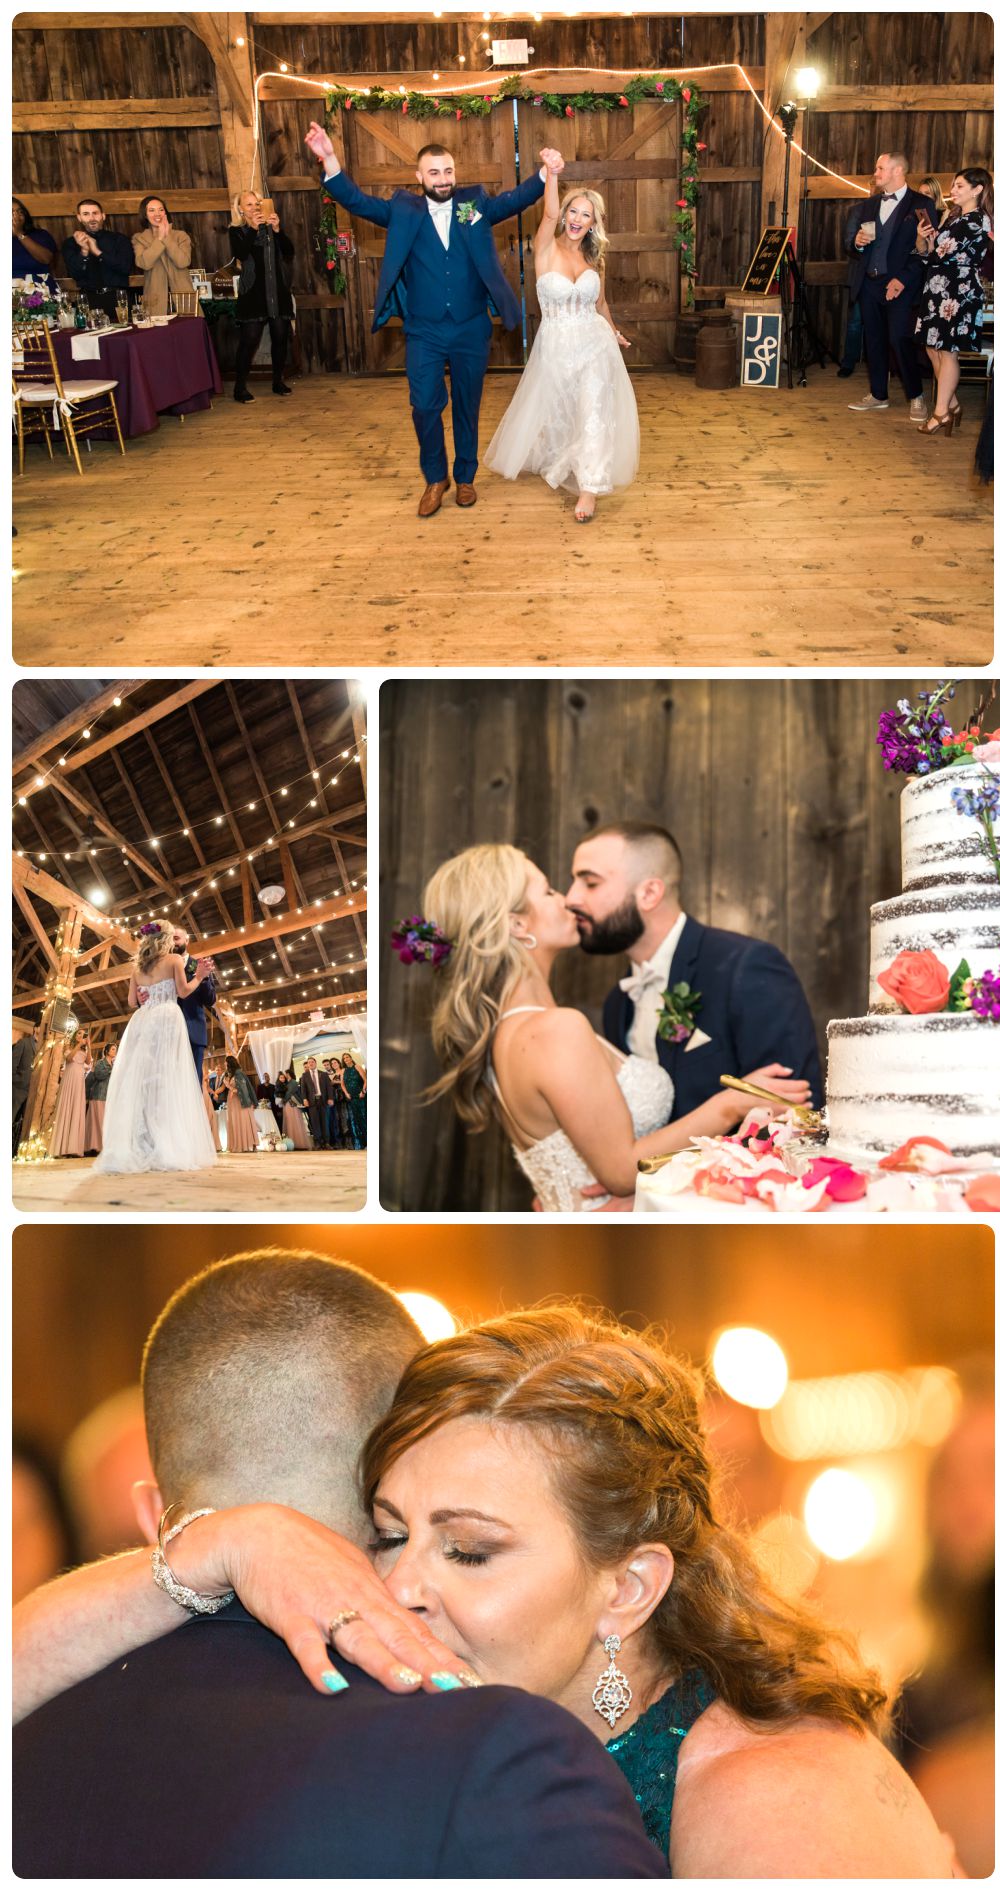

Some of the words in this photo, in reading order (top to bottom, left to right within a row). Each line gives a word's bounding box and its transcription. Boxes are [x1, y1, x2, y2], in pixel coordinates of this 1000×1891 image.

[746, 316, 763, 342] J
[754, 336, 778, 368] &
[743, 358, 767, 385] D
